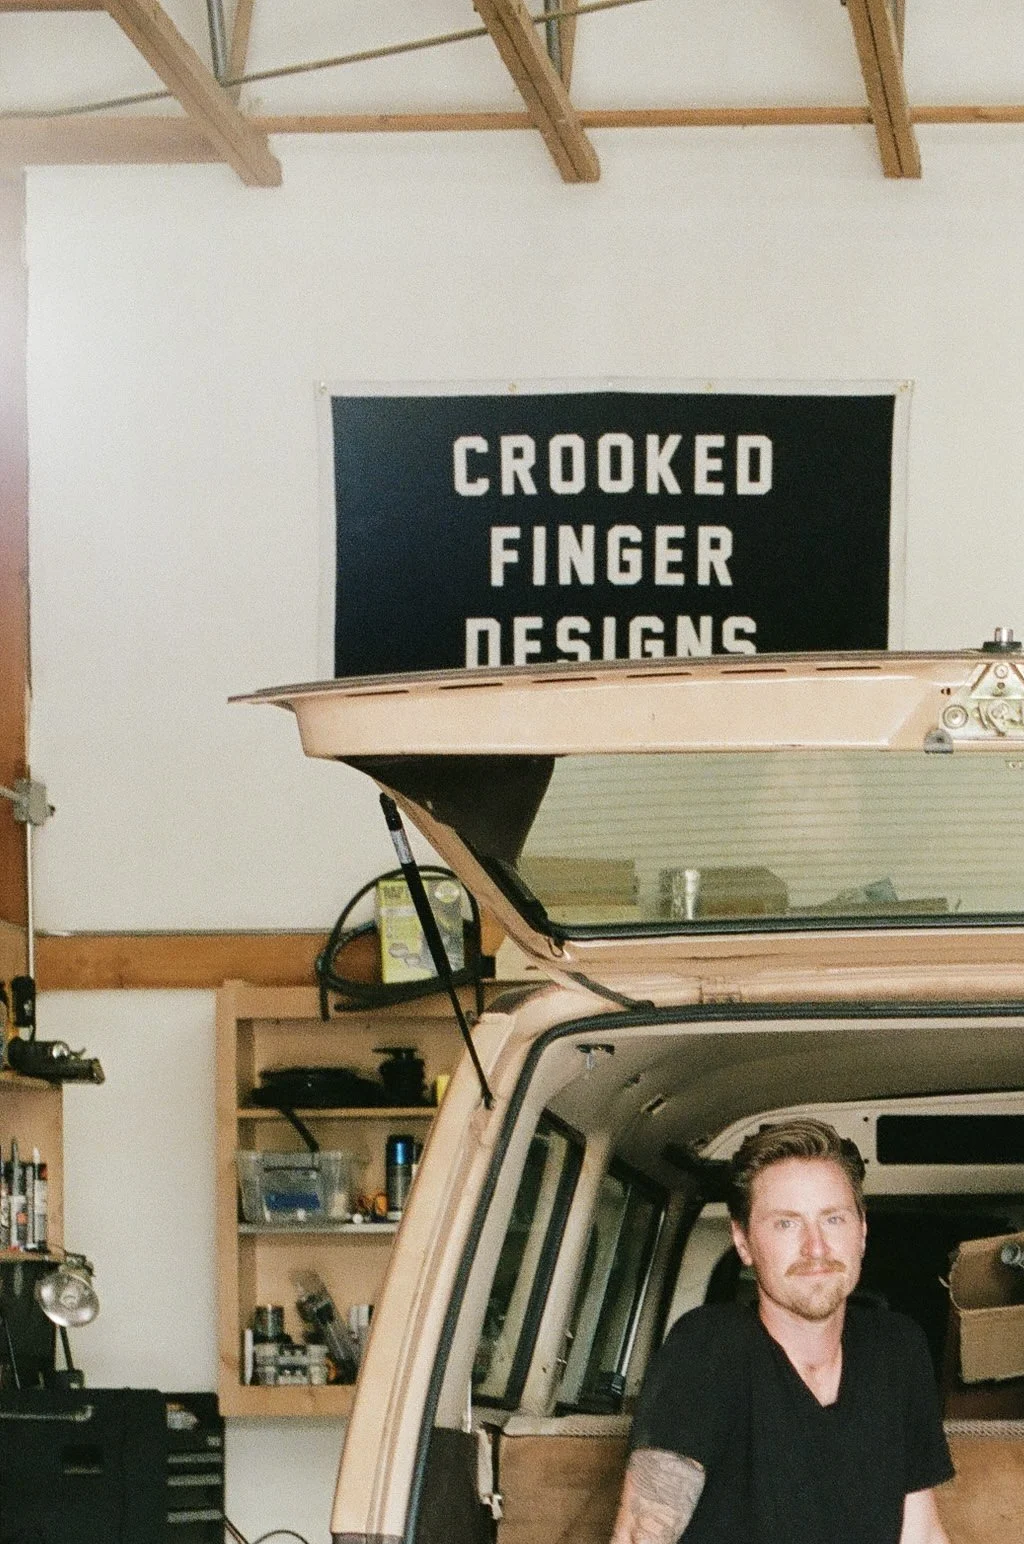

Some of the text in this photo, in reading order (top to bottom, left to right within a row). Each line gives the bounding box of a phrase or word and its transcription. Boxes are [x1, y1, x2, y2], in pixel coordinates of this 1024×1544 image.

[452, 432, 774, 498] CROOKED
[489, 524, 734, 588] FINGER
[465, 615, 758, 670] DESIGNS
